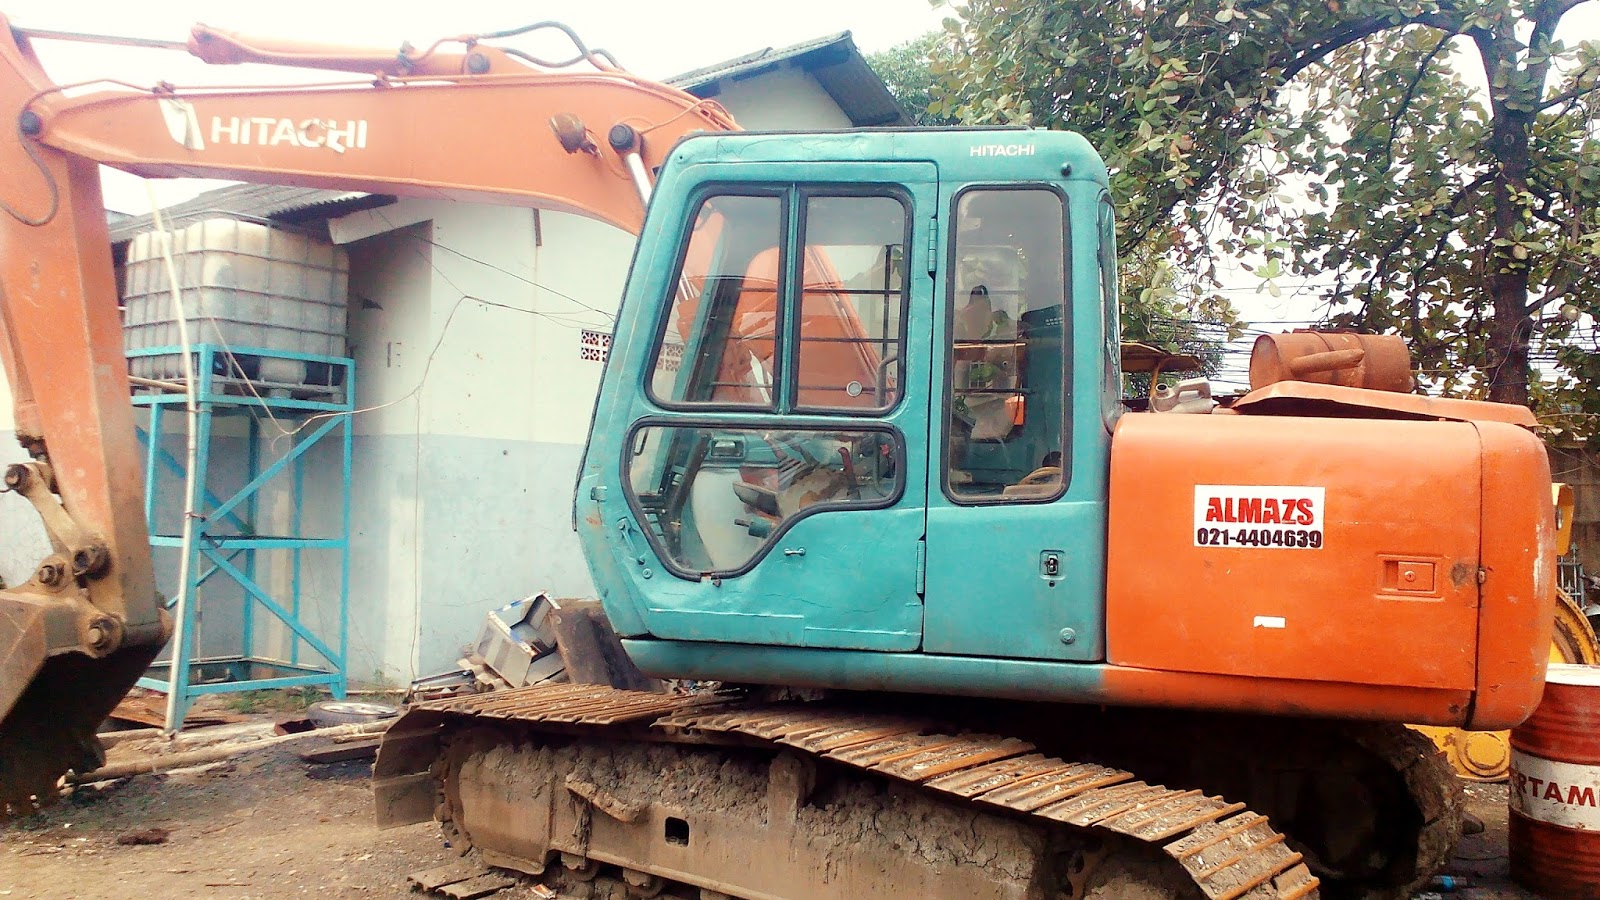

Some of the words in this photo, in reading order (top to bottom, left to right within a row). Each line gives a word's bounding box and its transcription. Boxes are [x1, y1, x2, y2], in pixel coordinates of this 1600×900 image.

[211, 116, 368, 152] HITACHI
[969, 144, 1035, 157] HITACHI
[1205, 497, 1314, 525] ALMAZS
[1197, 527, 1322, 548] 021-4404639
[1511, 768, 1600, 807] RTAM
